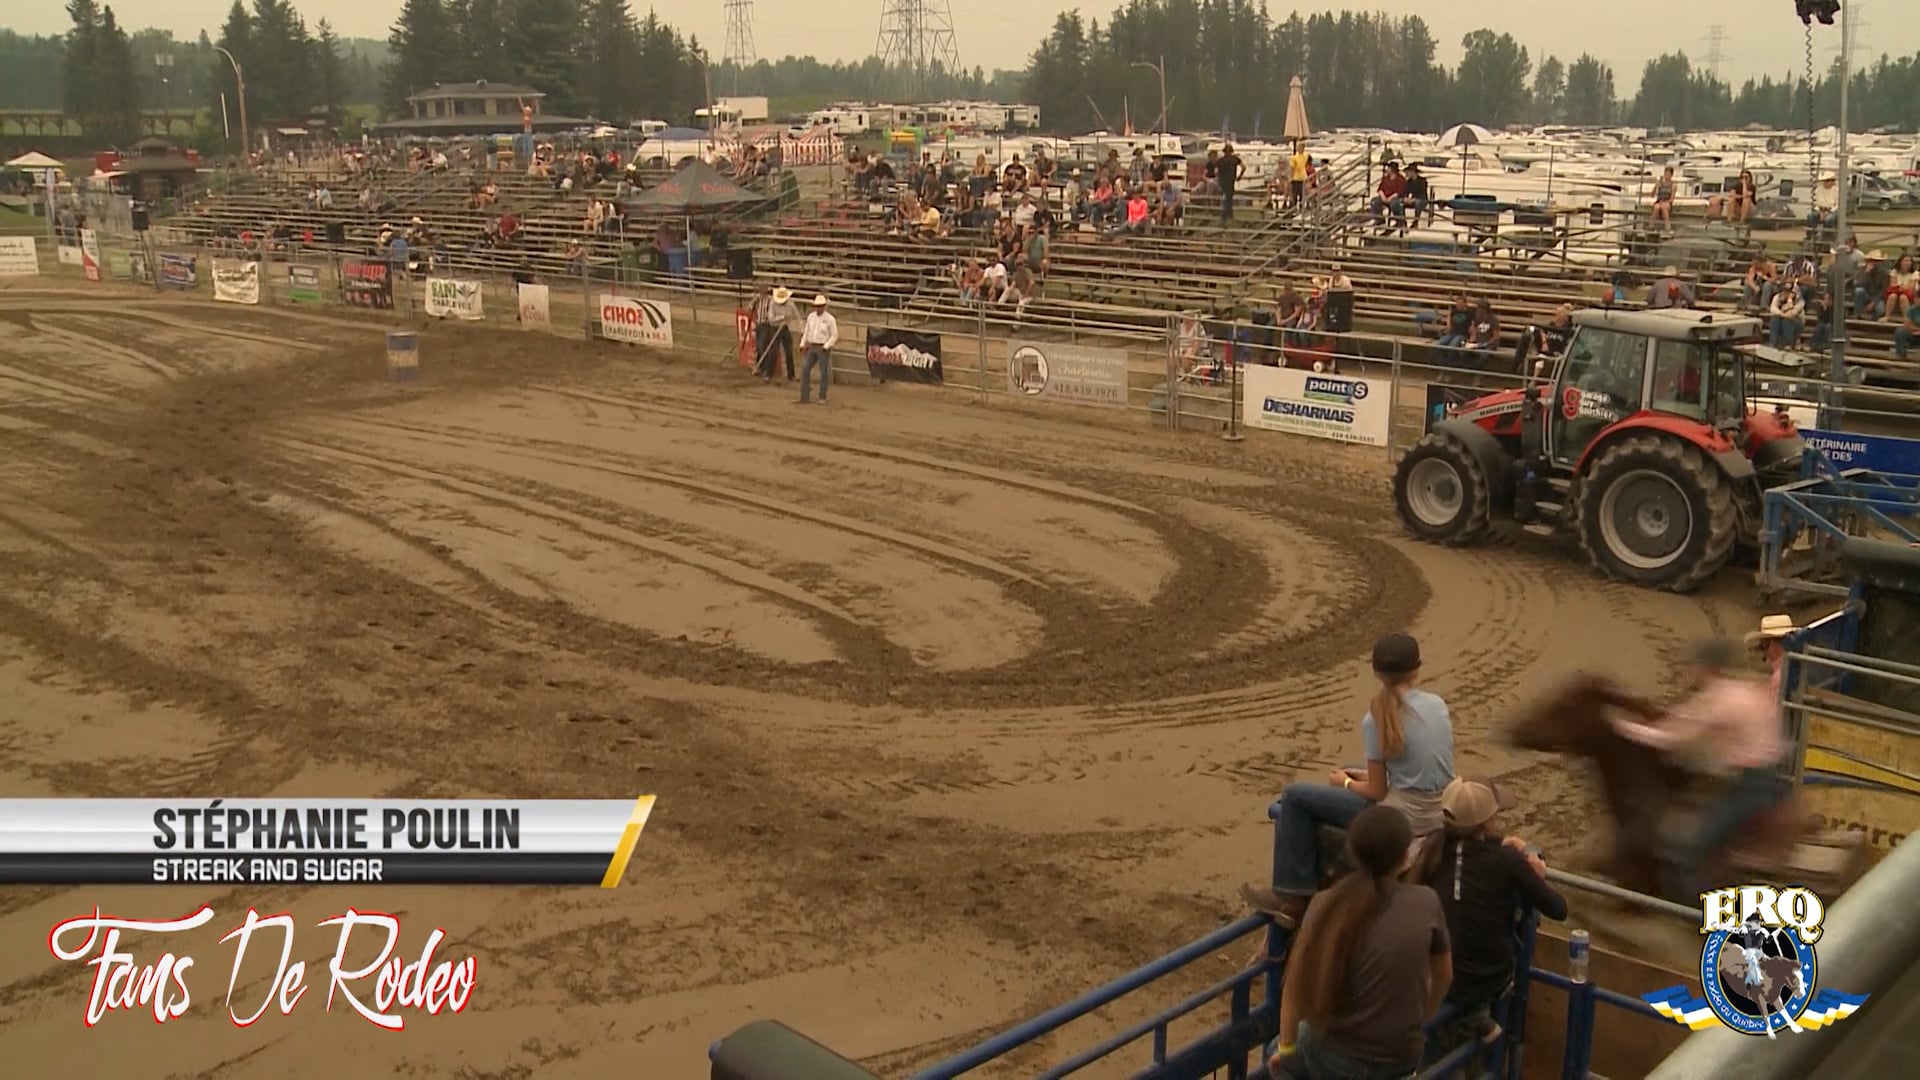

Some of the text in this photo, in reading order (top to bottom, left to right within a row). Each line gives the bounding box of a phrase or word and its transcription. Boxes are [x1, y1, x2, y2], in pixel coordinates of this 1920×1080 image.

[603, 305, 637, 325] CIHO
[1309, 380, 1347, 393] point
[1263, 398, 1354, 423] DESHARNAIS
[1832, 451, 1852, 461] DES
